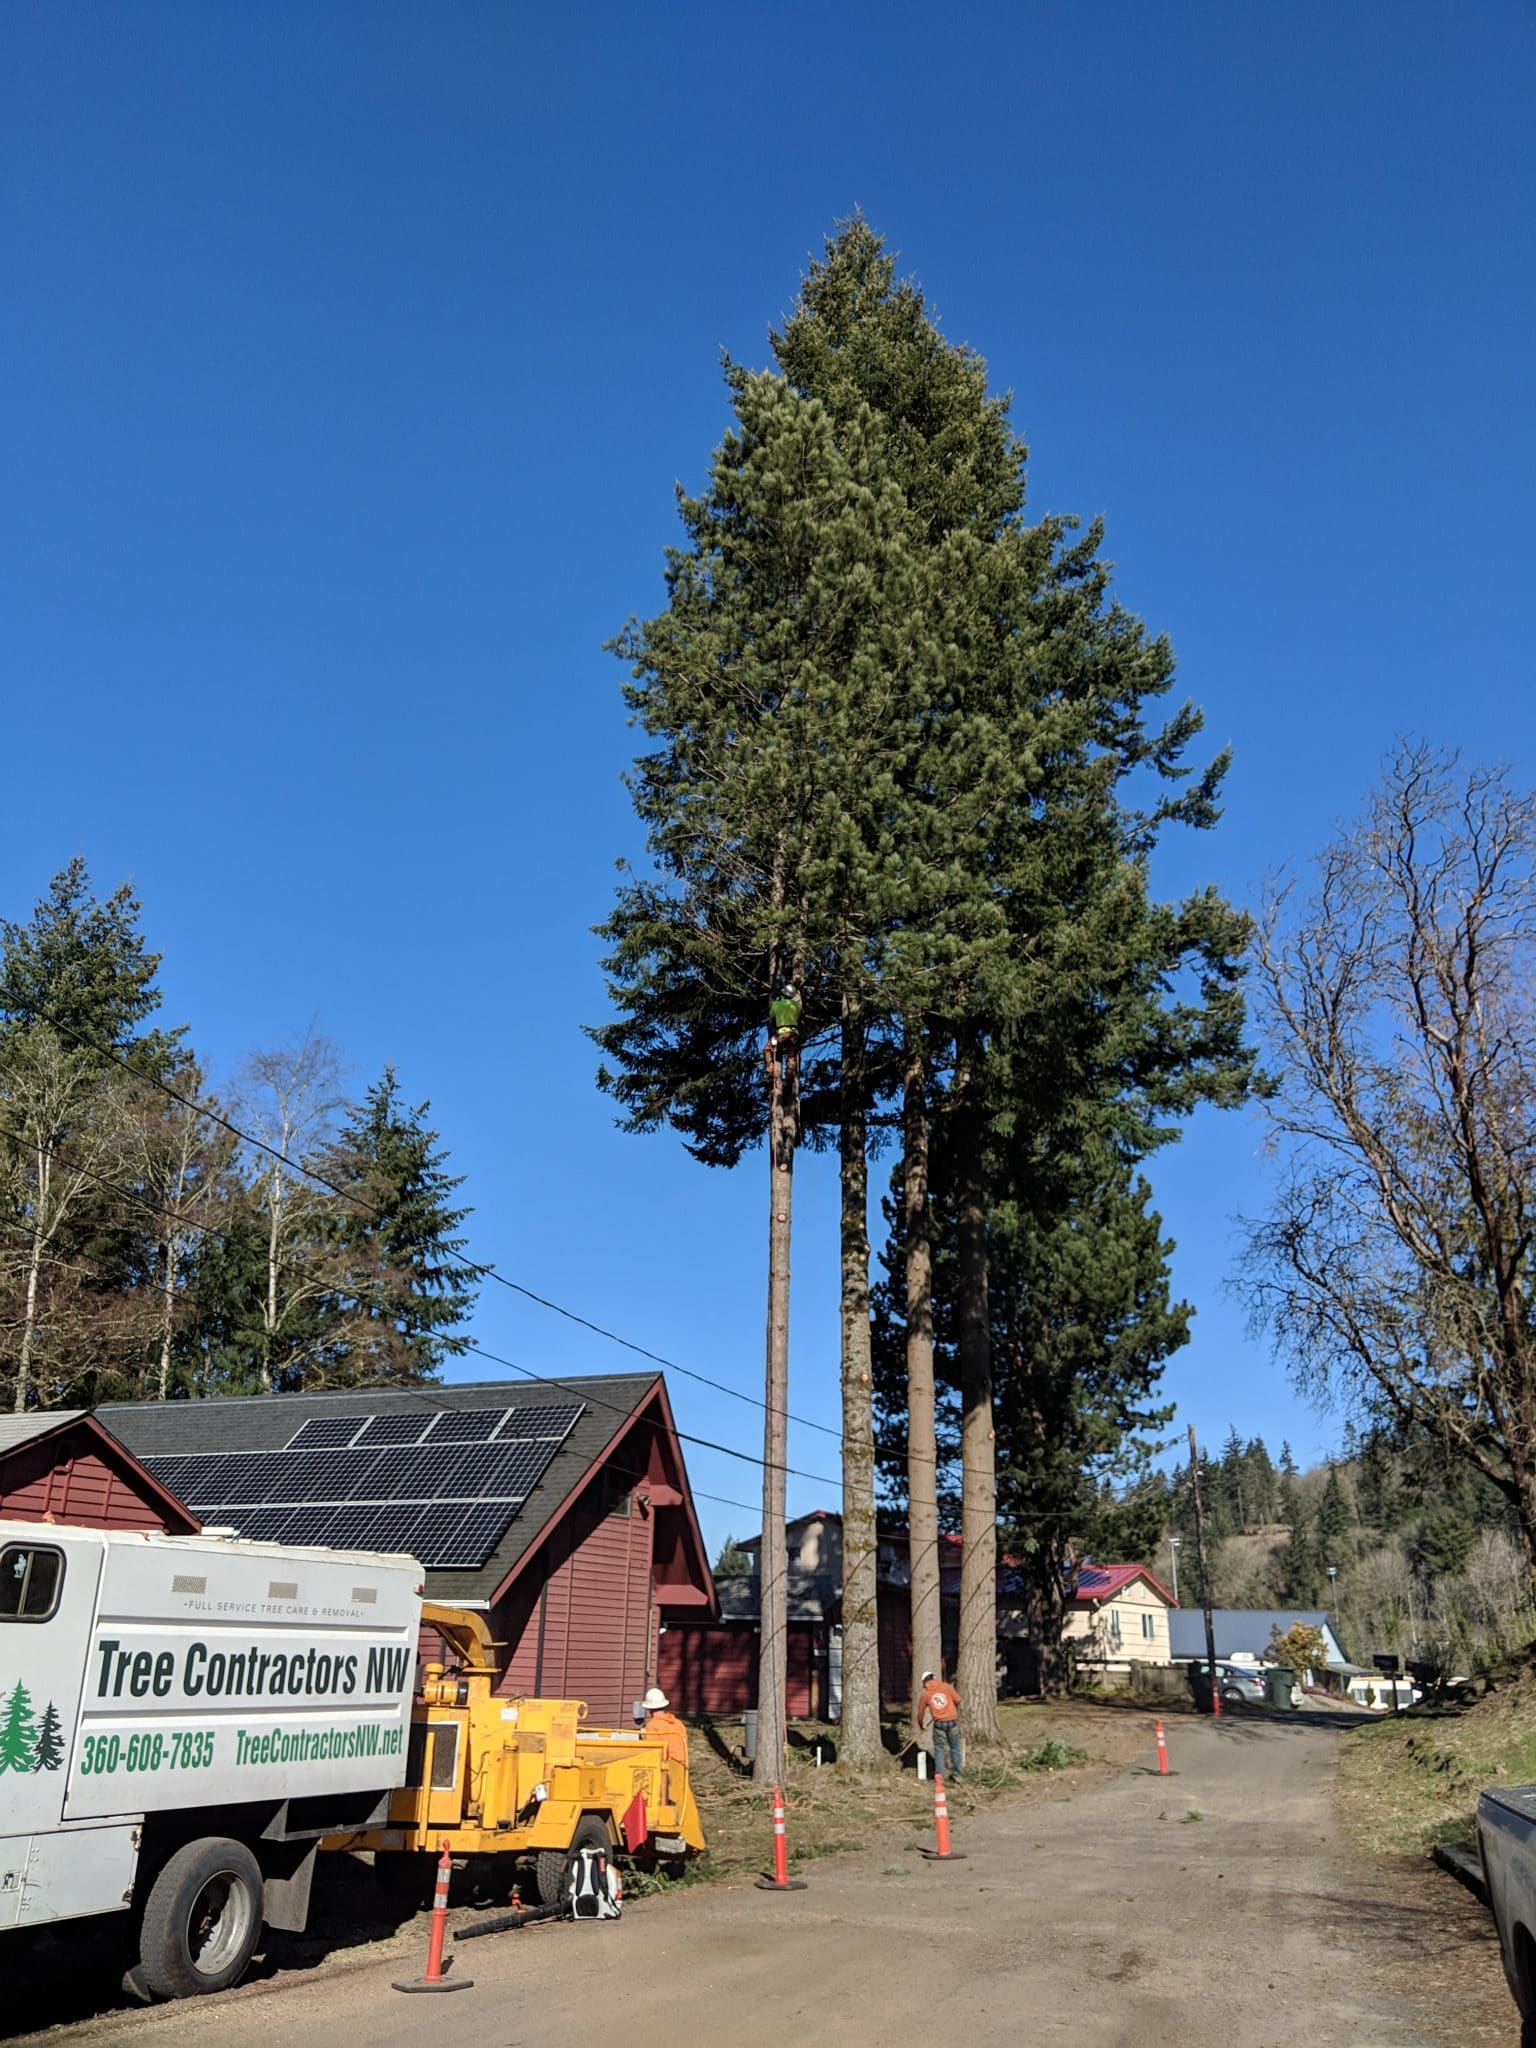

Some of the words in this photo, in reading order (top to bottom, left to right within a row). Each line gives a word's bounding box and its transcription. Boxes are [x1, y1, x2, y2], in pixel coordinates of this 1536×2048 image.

[216, 1602, 257, 1613] SERVICE
[261, 1604, 283, 1614] TREE
[286, 1606, 309, 1616] CARE
[312, 1608, 319, 1616] &
[98, 1640, 174, 1697] Tree
[183, 1642, 358, 1696] Contractors
[365, 1647, 411, 1694] NW
[80, 1731, 215, 1775] 360-608-7835
[236, 1724, 403, 1766] TreeContractorsNW.net
